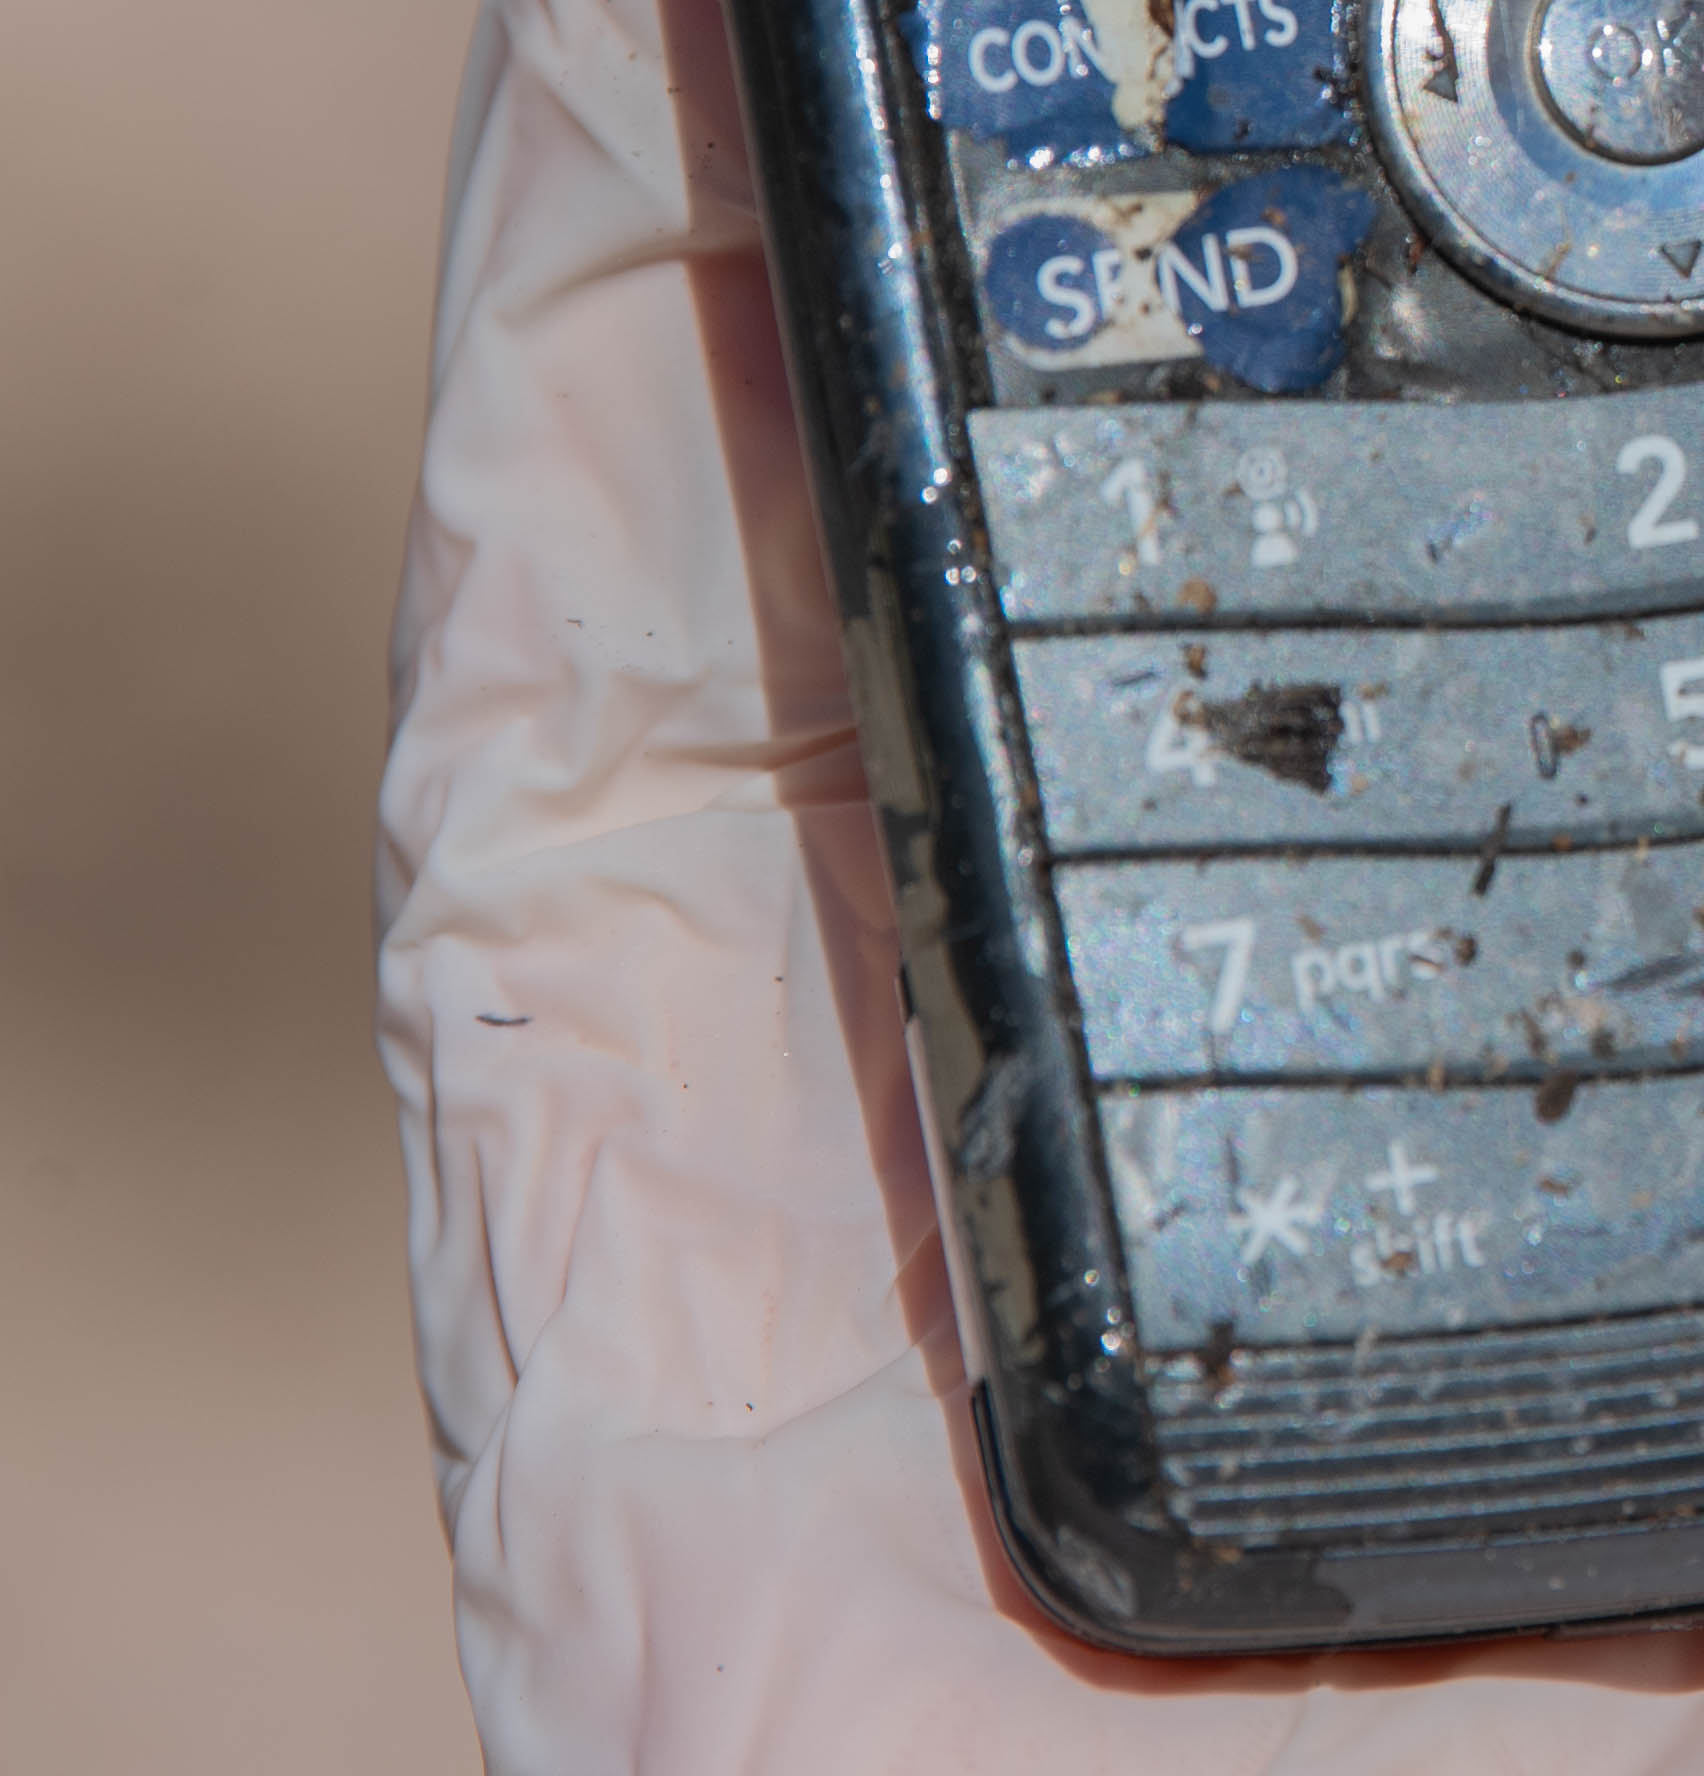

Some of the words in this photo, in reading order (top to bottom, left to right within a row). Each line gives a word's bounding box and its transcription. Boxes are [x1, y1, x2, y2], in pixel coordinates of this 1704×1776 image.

[1100, 457, 1160, 566] 1
[1615, 434, 1699, 550] 2
[1180, 916, 1257, 1031] 7
